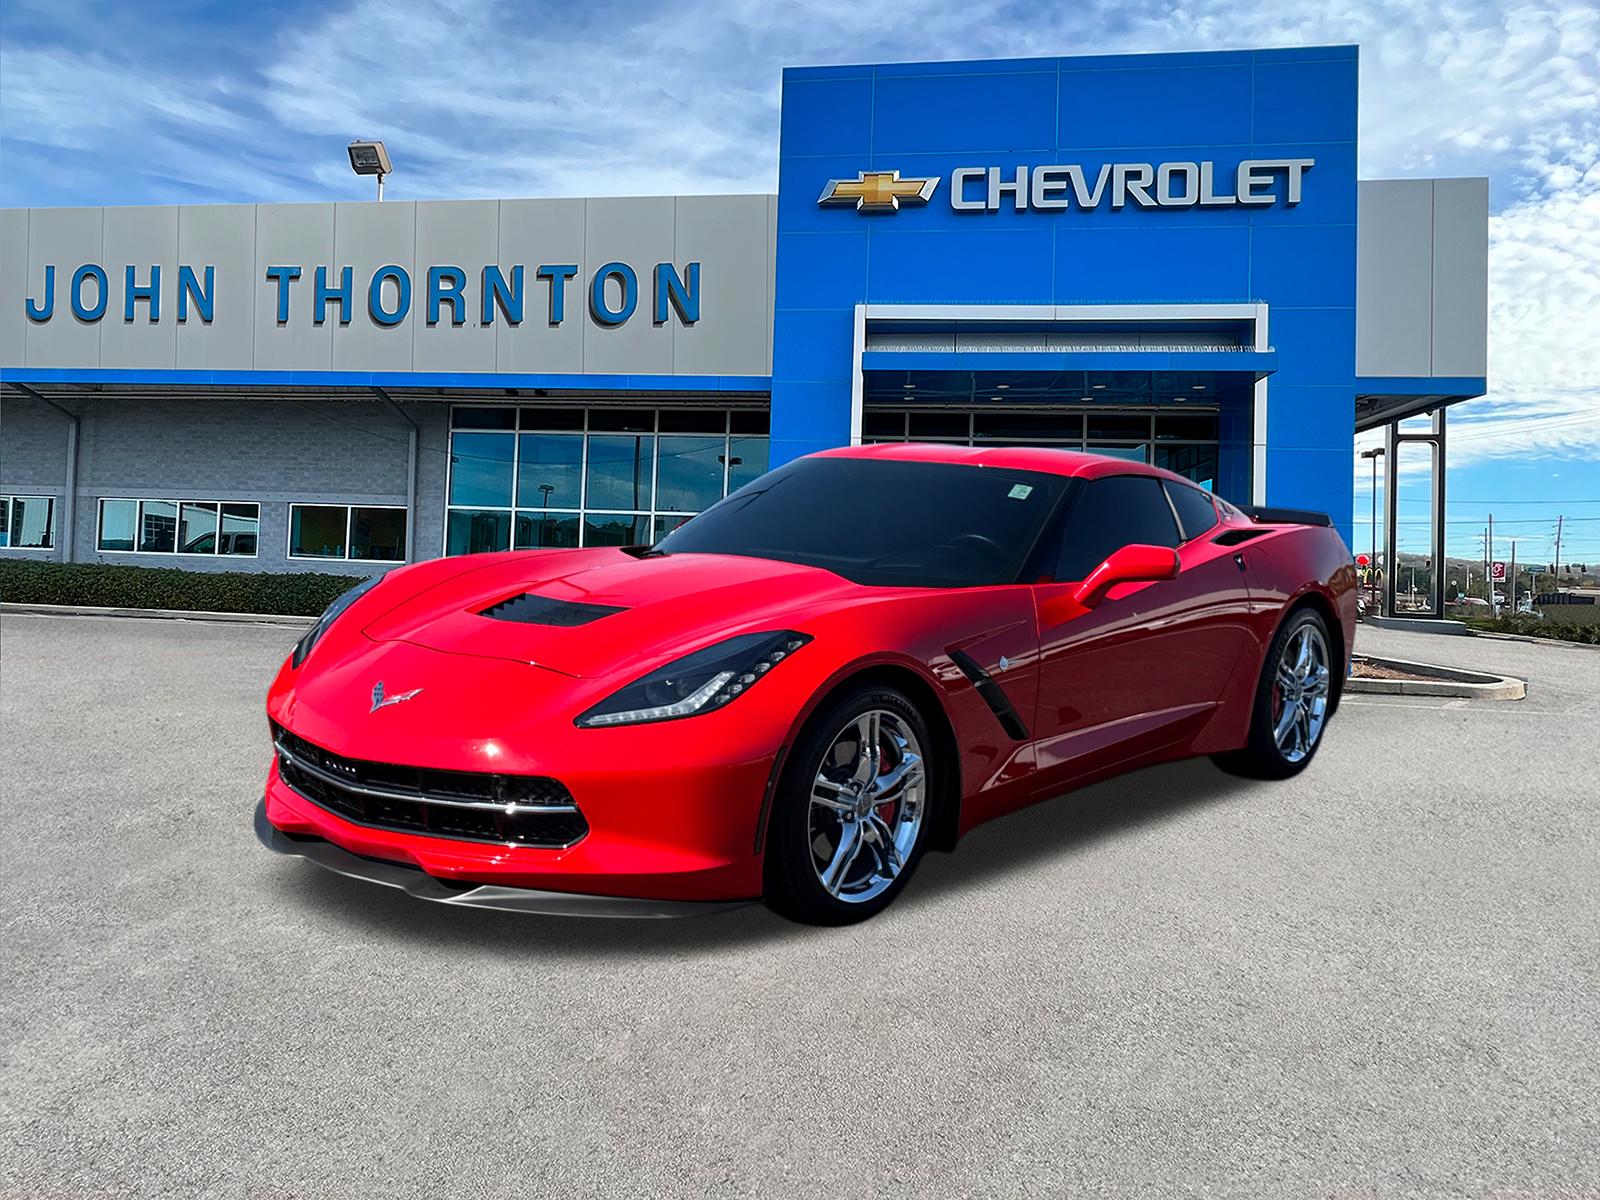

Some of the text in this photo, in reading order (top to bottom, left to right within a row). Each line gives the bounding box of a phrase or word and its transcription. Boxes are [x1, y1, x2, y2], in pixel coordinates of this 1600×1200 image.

[950, 158, 1315, 211] CHEVROLET
[25, 261, 701, 327] JOHN THORNTON
